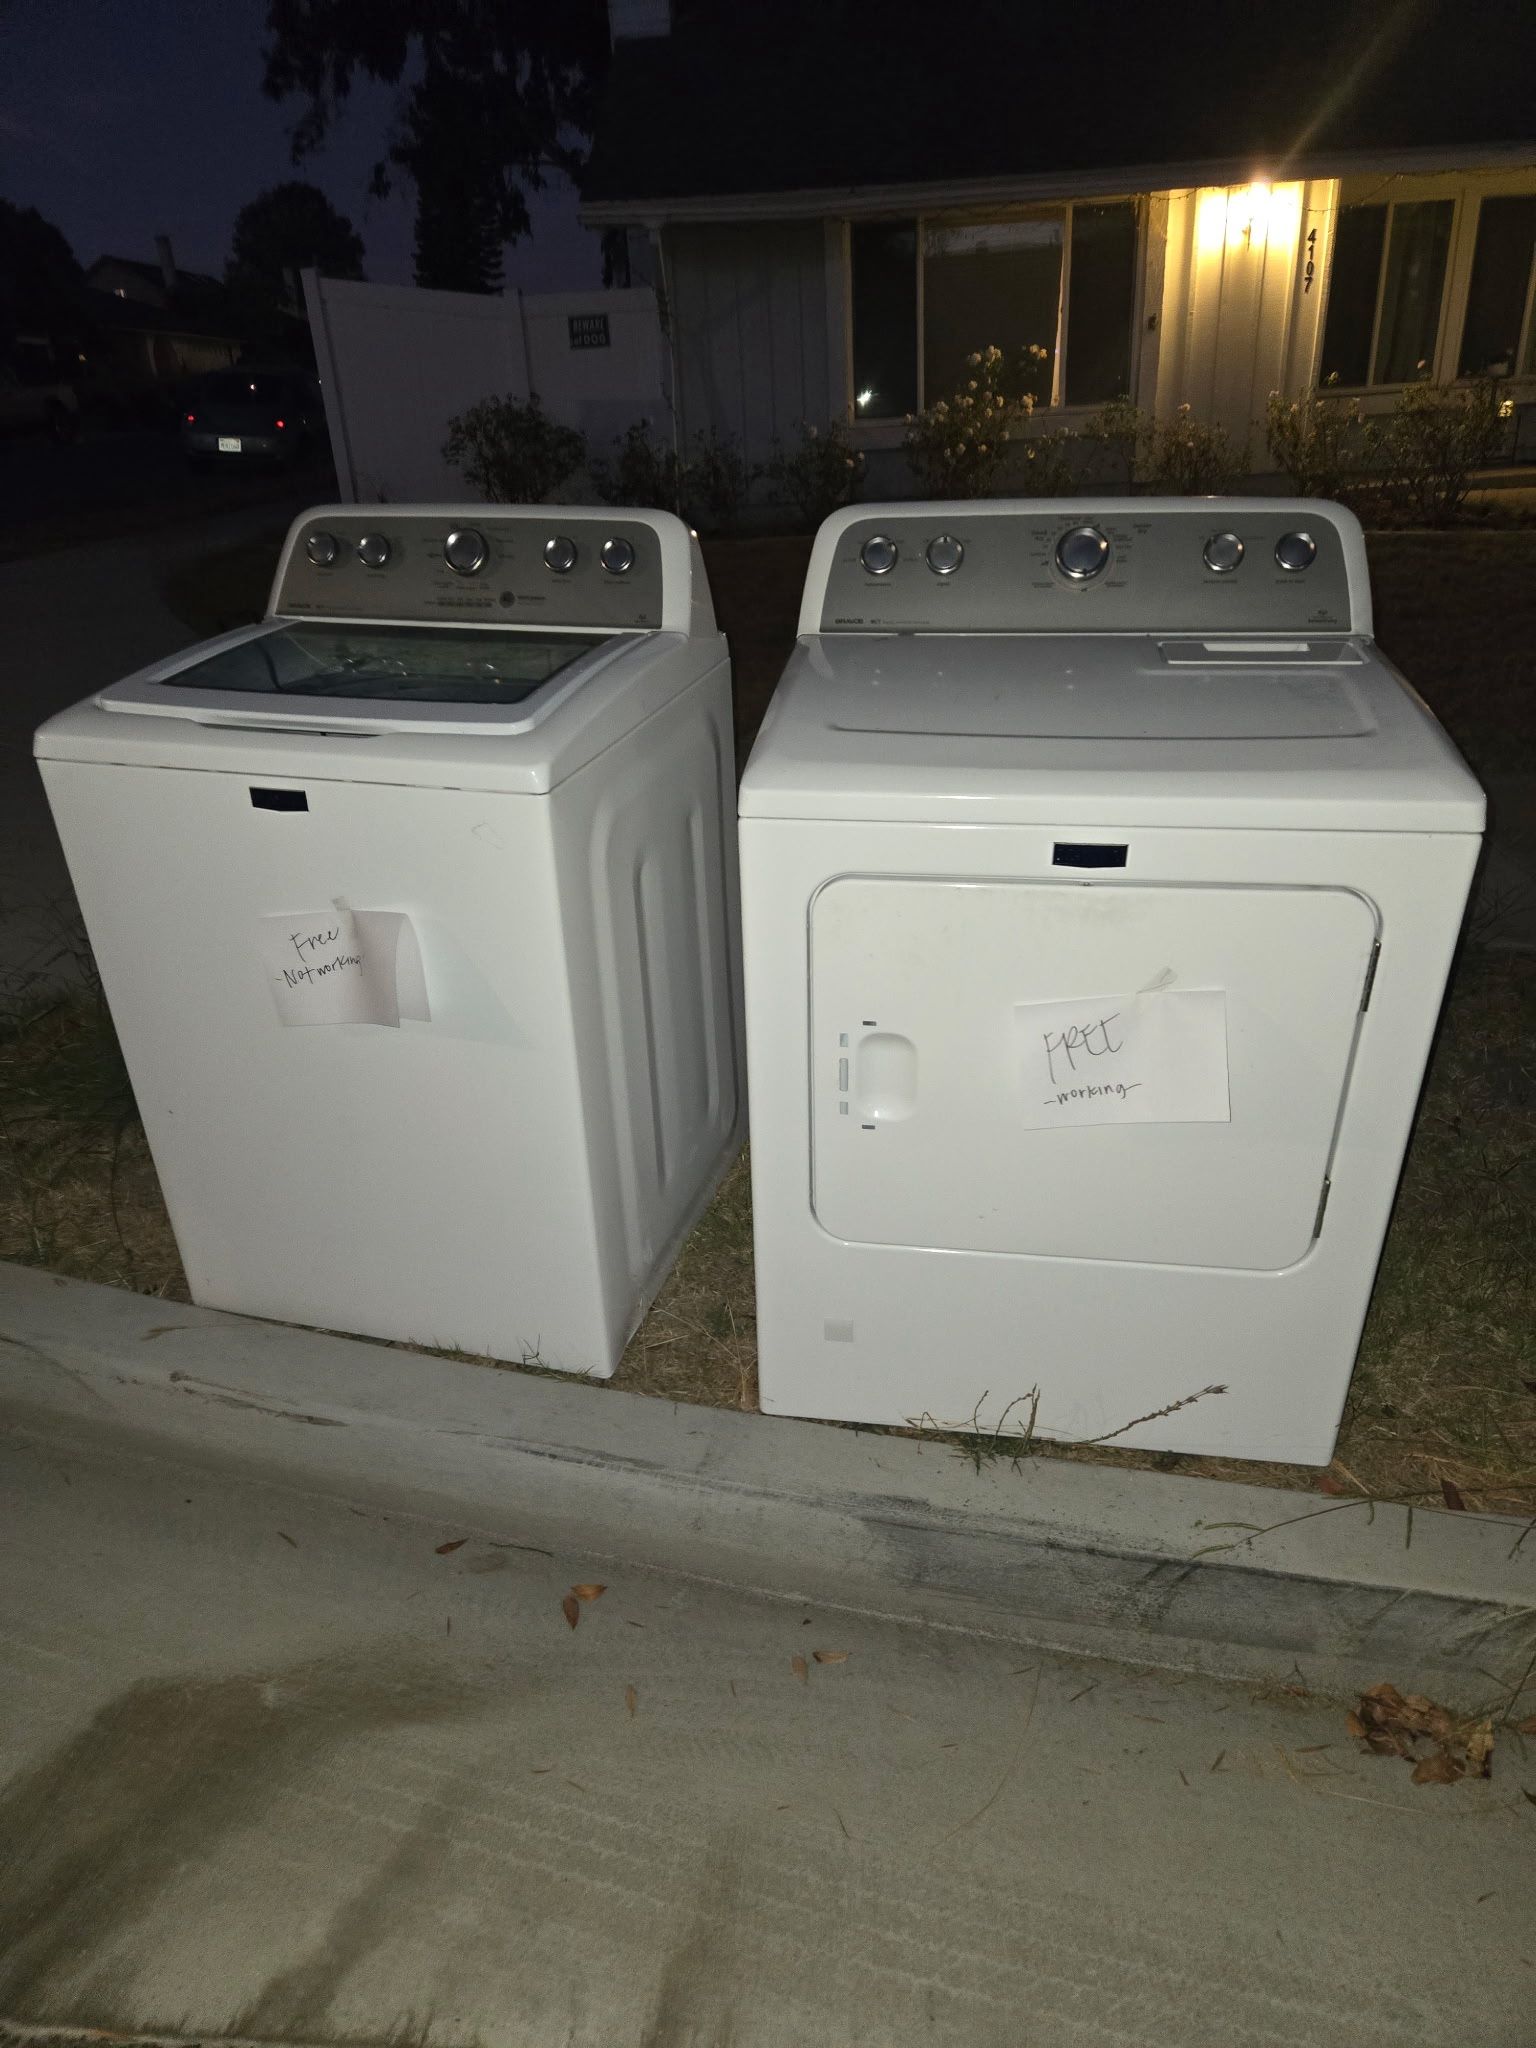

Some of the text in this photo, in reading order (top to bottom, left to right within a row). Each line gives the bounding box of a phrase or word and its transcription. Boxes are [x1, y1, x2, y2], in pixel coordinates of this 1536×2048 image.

[1304, 228, 1317, 294] 4107
[289, 927, 339, 963] Free
[1043, 1012, 1124, 1085] FREE
